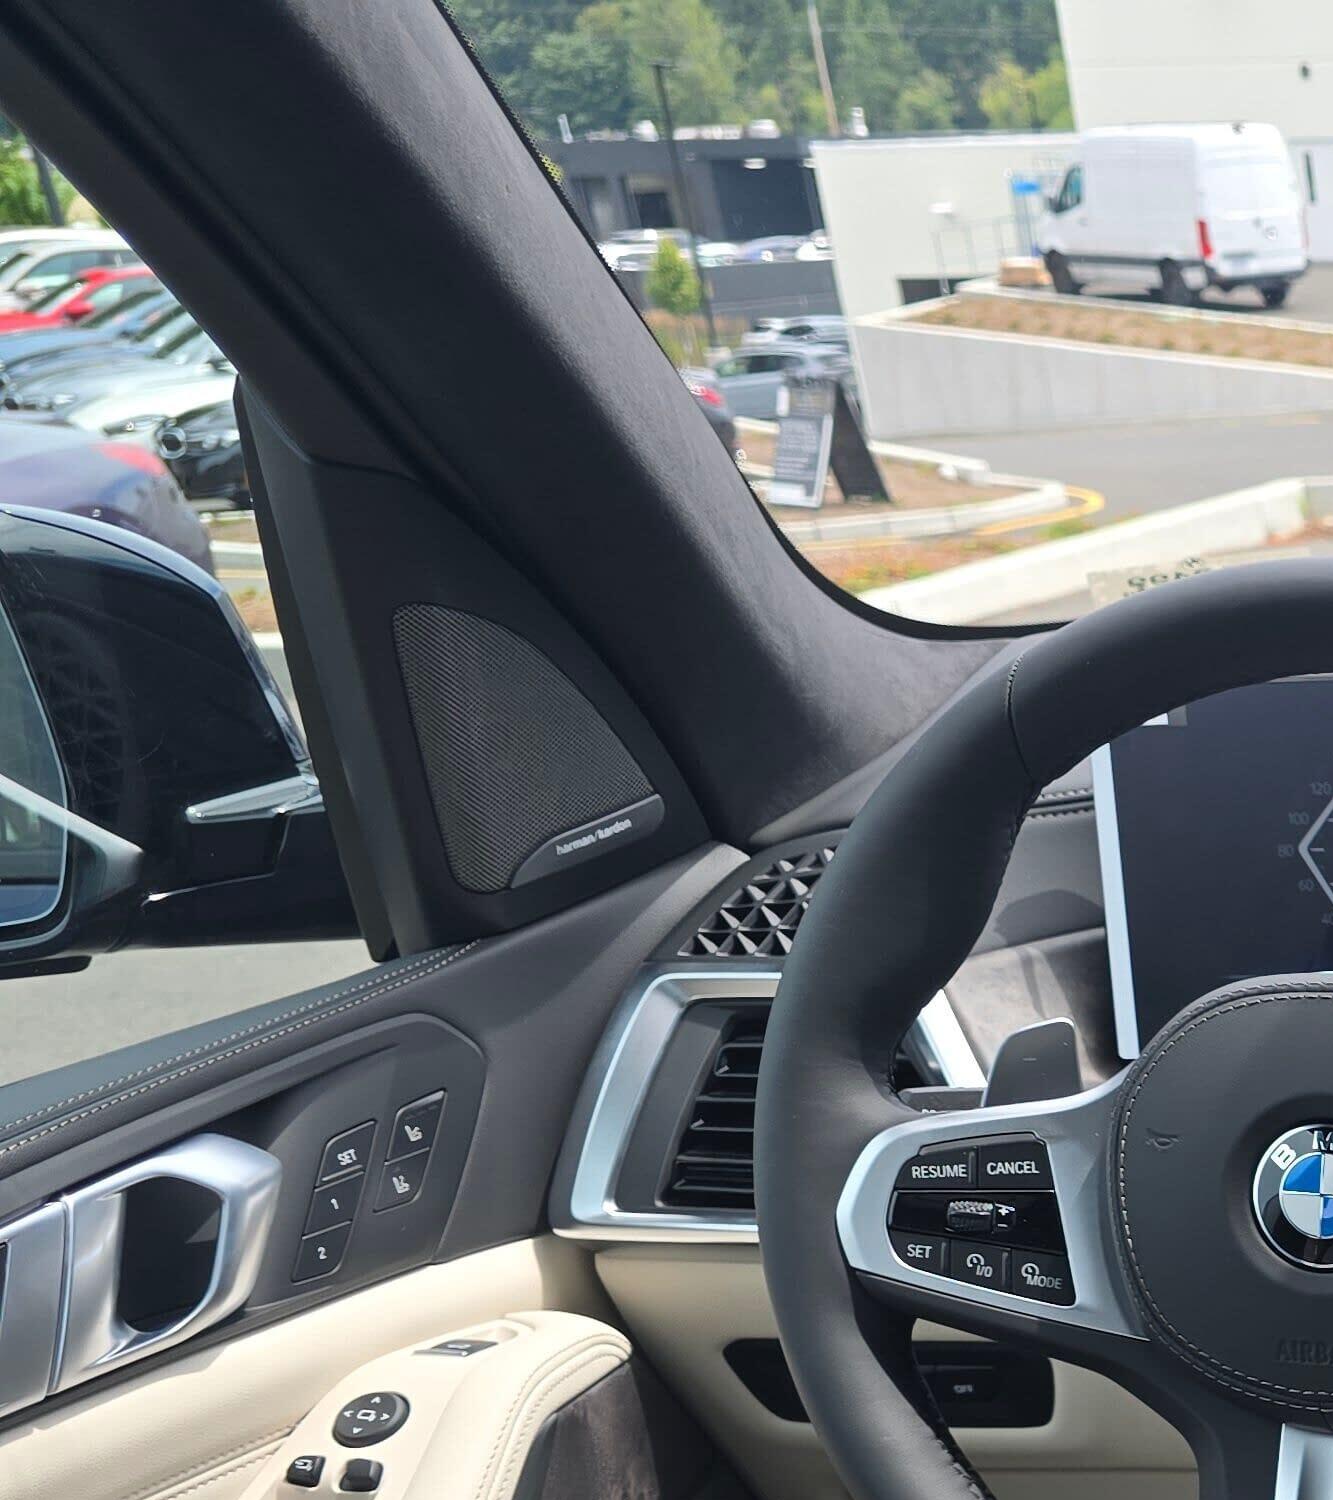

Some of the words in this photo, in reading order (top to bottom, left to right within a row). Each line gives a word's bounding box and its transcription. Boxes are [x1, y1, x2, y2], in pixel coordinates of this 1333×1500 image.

[1310, 781, 1332, 795] 120
[1288, 812, 1309, 824] 100
[1298, 879, 1314, 892] 60
[336, 1148, 357, 1166] SET
[912, 1164, 967, 1179] RESUME
[987, 1161, 1040, 1175] CANCEL
[330, 1198, 340, 1210] 1
[317, 1246, 328, 1260] 2
[907, 1244, 933, 1259] SET
[1026, 1275, 1063, 1289] MODE
